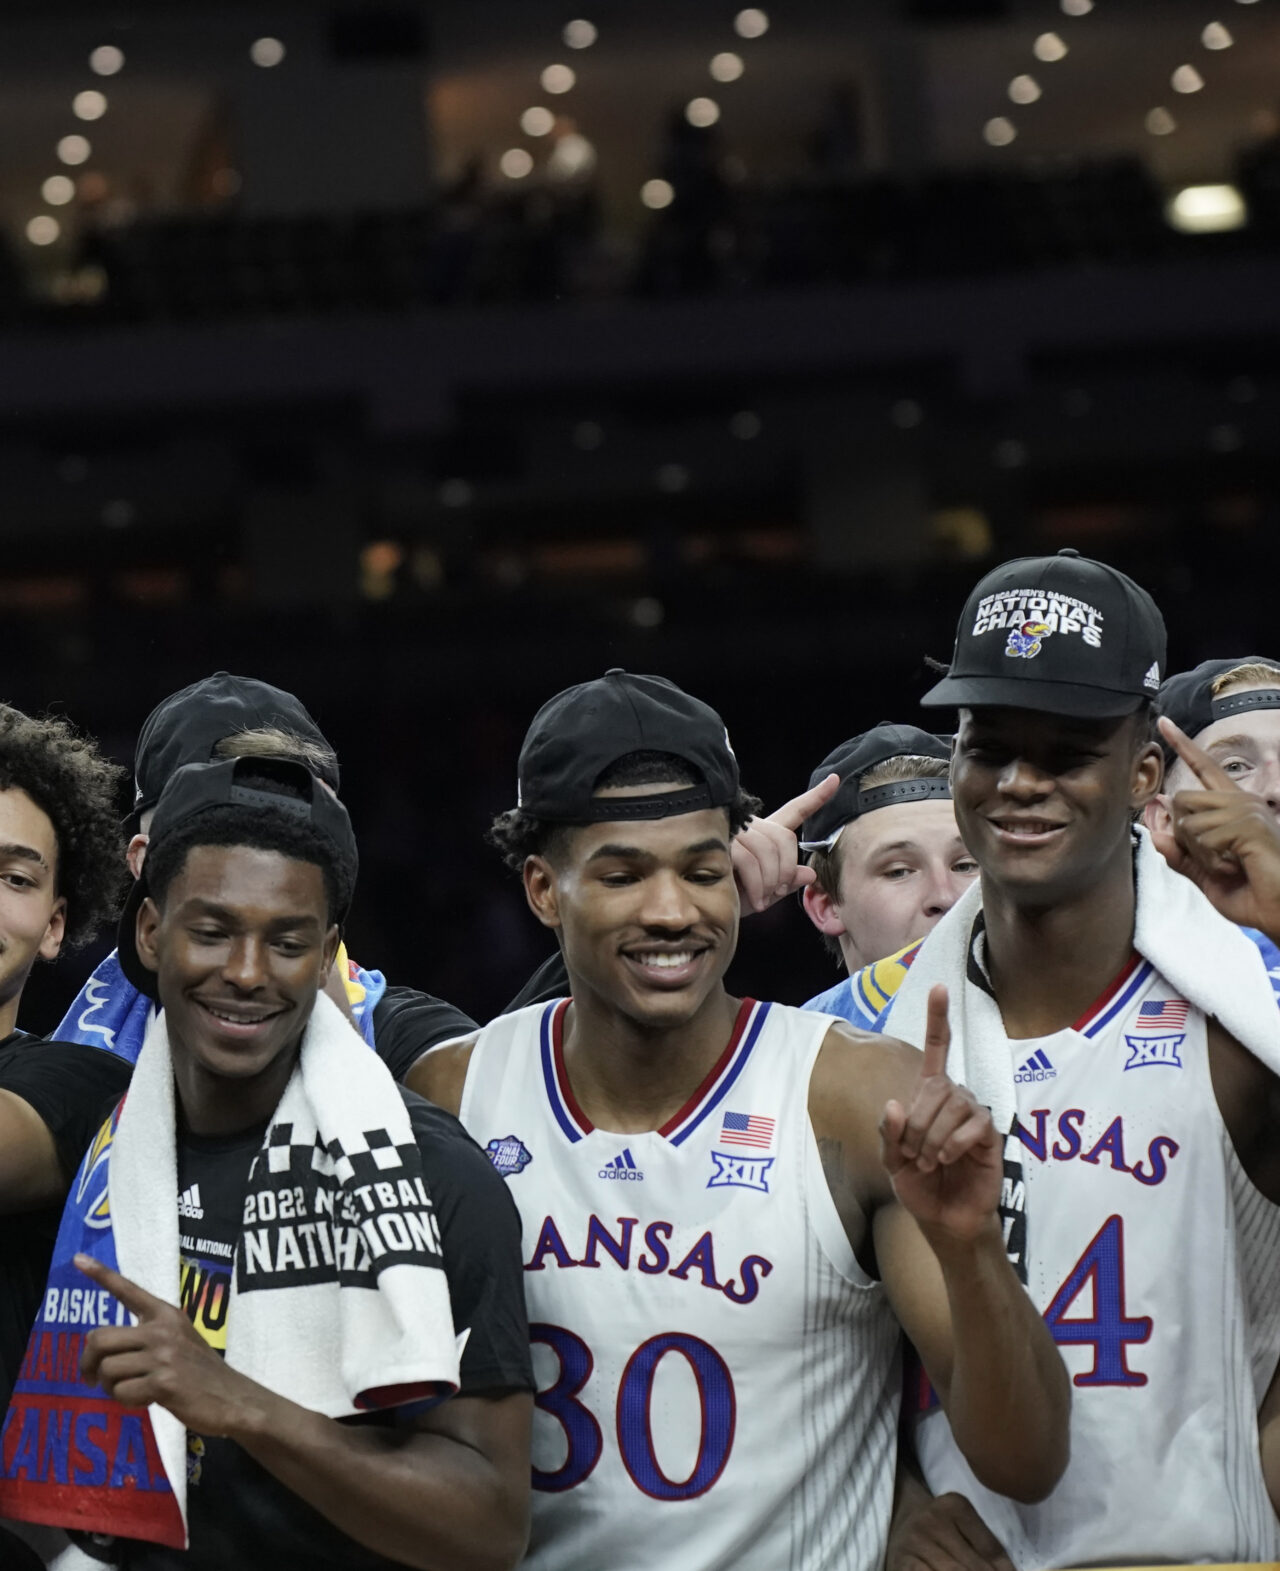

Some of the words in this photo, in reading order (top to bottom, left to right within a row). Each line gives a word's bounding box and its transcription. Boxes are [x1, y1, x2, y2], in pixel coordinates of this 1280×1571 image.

[972, 609, 1102, 648] CHAMPS
[976, 596, 1103, 633] NATIONAL
[1014, 1068, 1057, 1083] adidas
[598, 1167, 644, 1181] adidas
[243, 1186, 307, 1225] 2022
[196, 1238, 233, 1258] NATIONAL
[523, 1204, 774, 1305] ANSAS
[529, 1322, 737, 1502] 30
